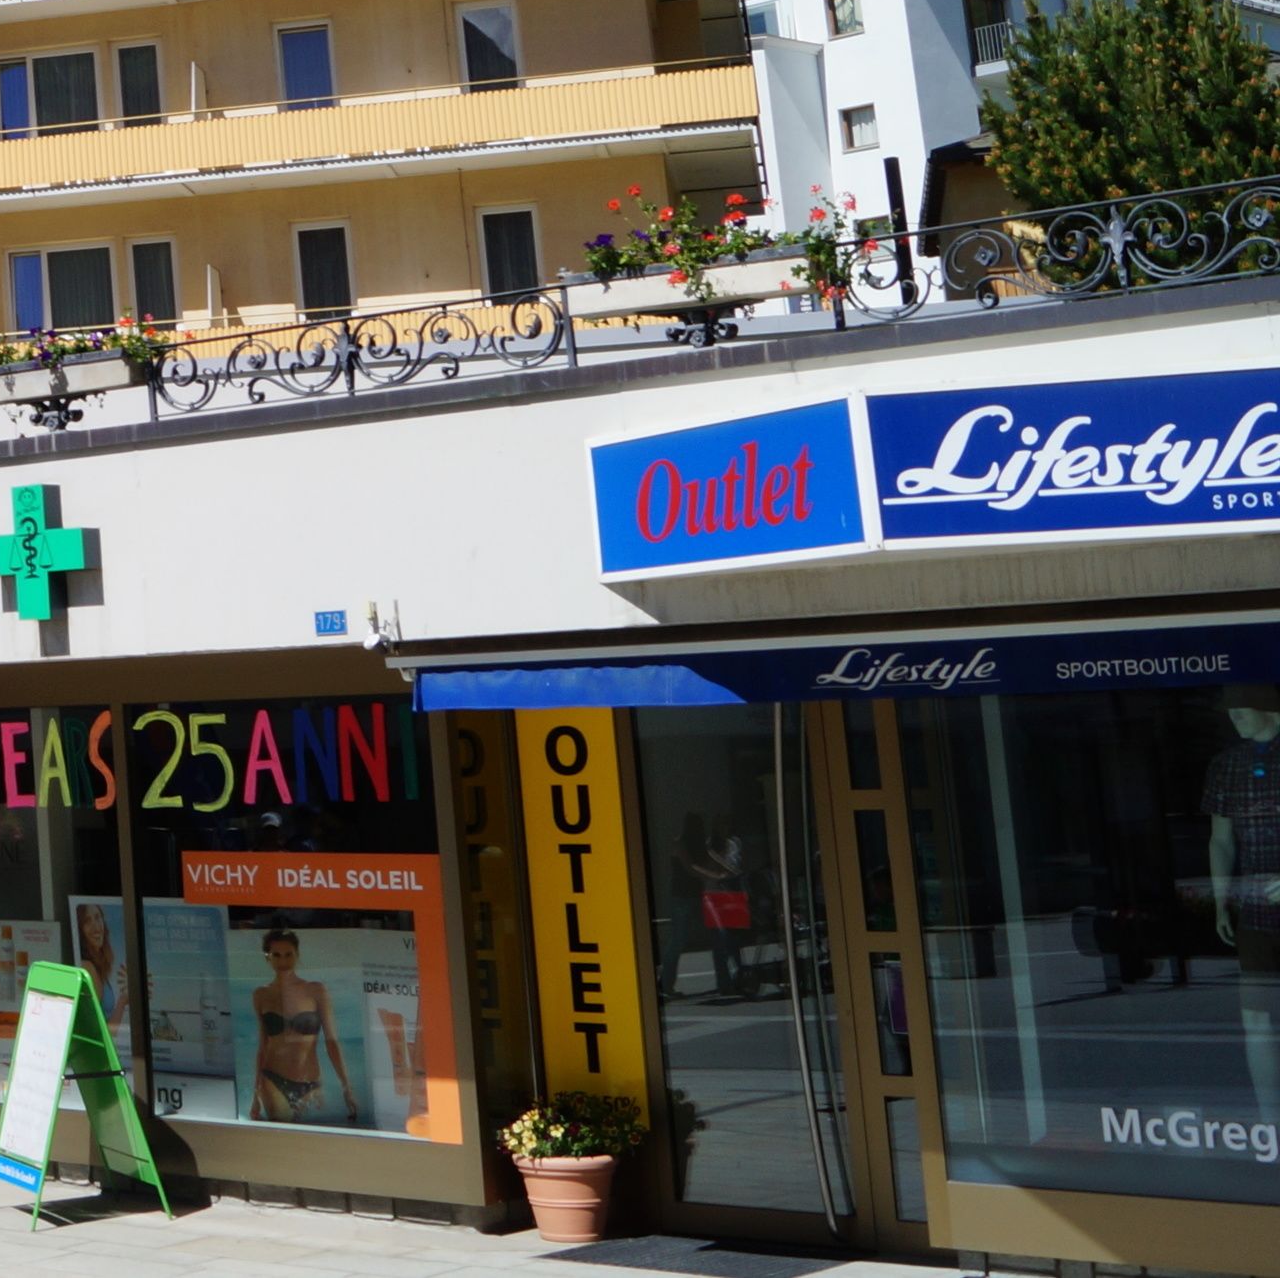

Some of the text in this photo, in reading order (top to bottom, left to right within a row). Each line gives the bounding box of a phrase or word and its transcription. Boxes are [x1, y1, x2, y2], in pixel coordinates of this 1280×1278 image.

[896, 402, 1280, 512] Lifestyle
[636, 439, 815, 544] Outlet
[316, 613, 341, 631] 179
[816, 647, 1231, 691] Lifestyle SPORTBOUTIQUE
[132, 709, 235, 813] 25
[243, 703, 419, 805] ANNI
[186, 864, 423, 891] VICHY IDÉAL SOLEIL
[544, 725, 608, 1074] OUTLET
[363, 979, 392, 995] IDÉAL
[1100, 1106, 1279, 1163] McGreg
